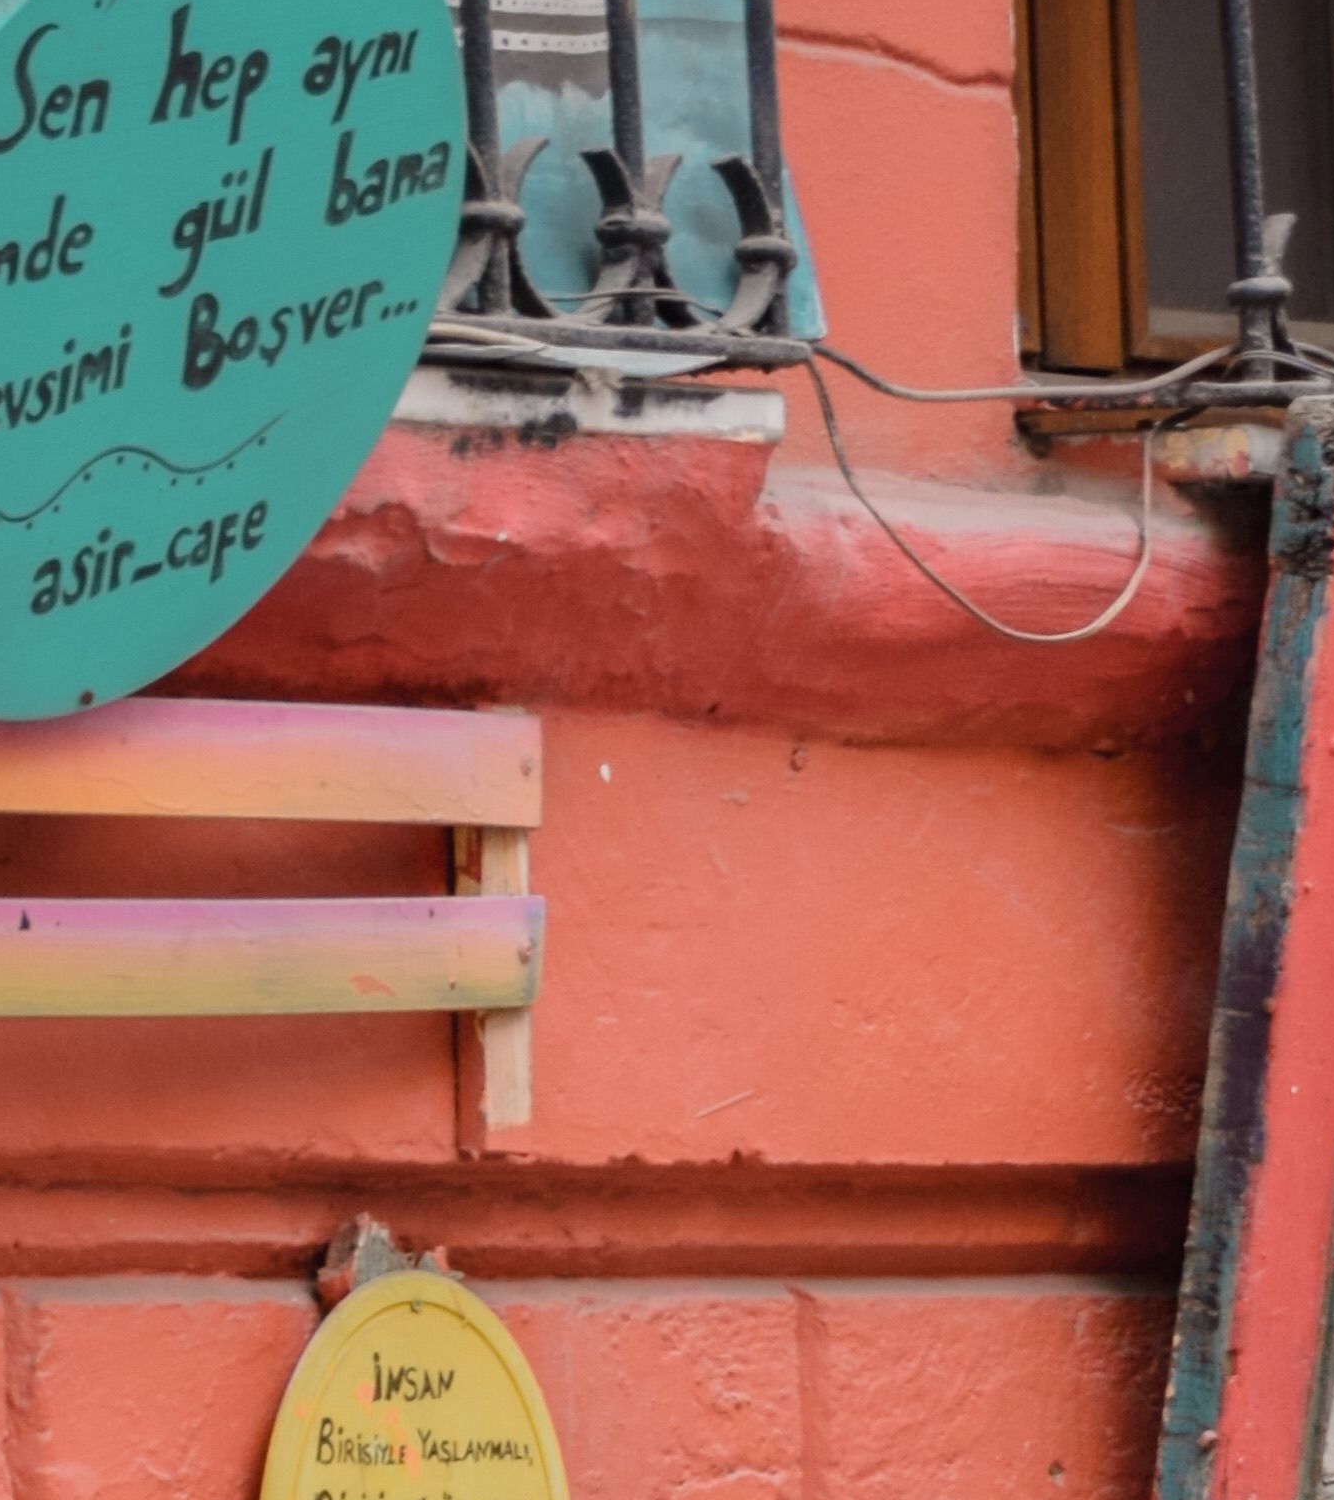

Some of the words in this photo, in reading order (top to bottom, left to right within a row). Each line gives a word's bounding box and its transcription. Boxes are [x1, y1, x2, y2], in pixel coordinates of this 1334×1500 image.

[150, 2, 271, 147] hep
[301, 28, 420, 125] aynı
[157, 145, 276, 300] gül
[324, 129, 451, 227] bana
[372, 1351, 455, 1402] İNSAN
